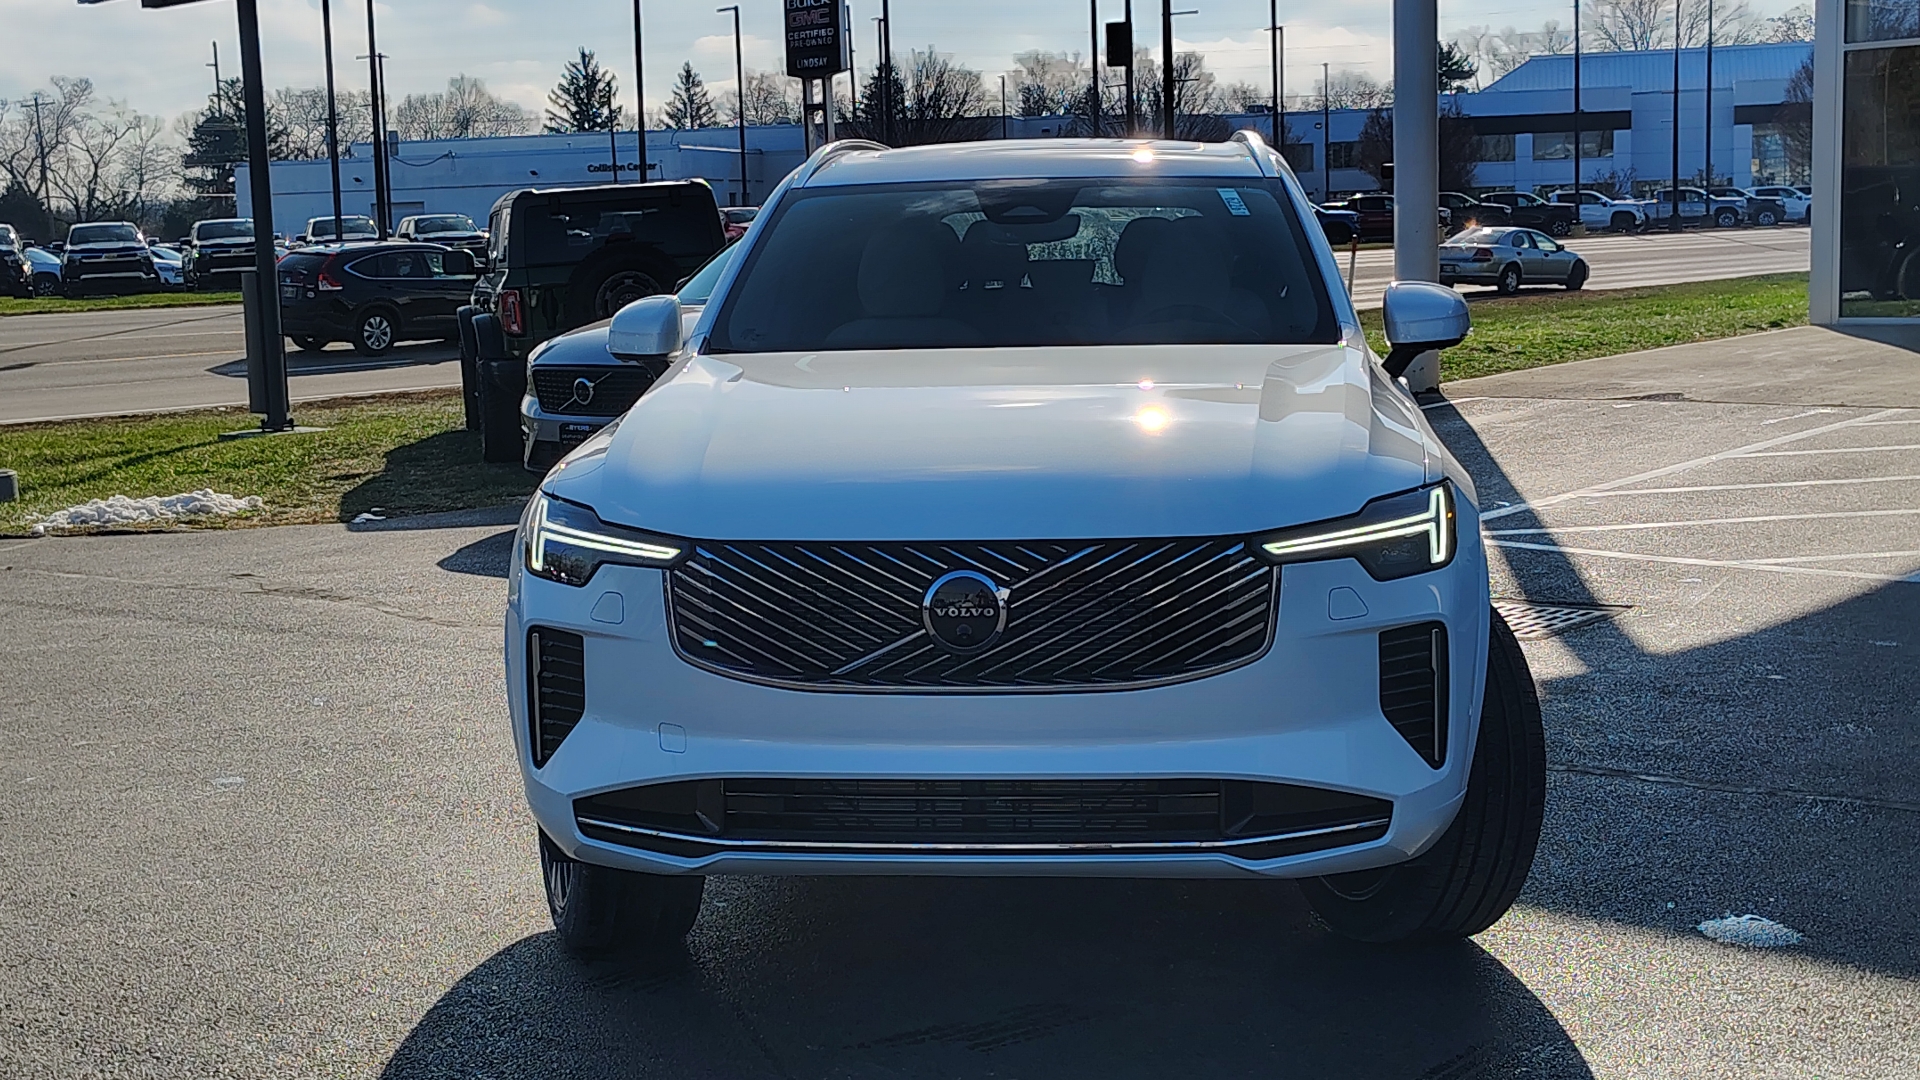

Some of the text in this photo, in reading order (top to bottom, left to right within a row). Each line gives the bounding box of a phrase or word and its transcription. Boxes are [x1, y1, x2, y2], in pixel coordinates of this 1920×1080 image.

[789, 8, 830, 28] GMC
[787, 27, 835, 41] CERTIFIED
[790, 36, 833, 48] PRE-OWNED
[796, 56, 828, 69] LINDSAY
[587, 162, 658, 173] Collison Ceer
[933, 607, 995, 617] VOLVO
